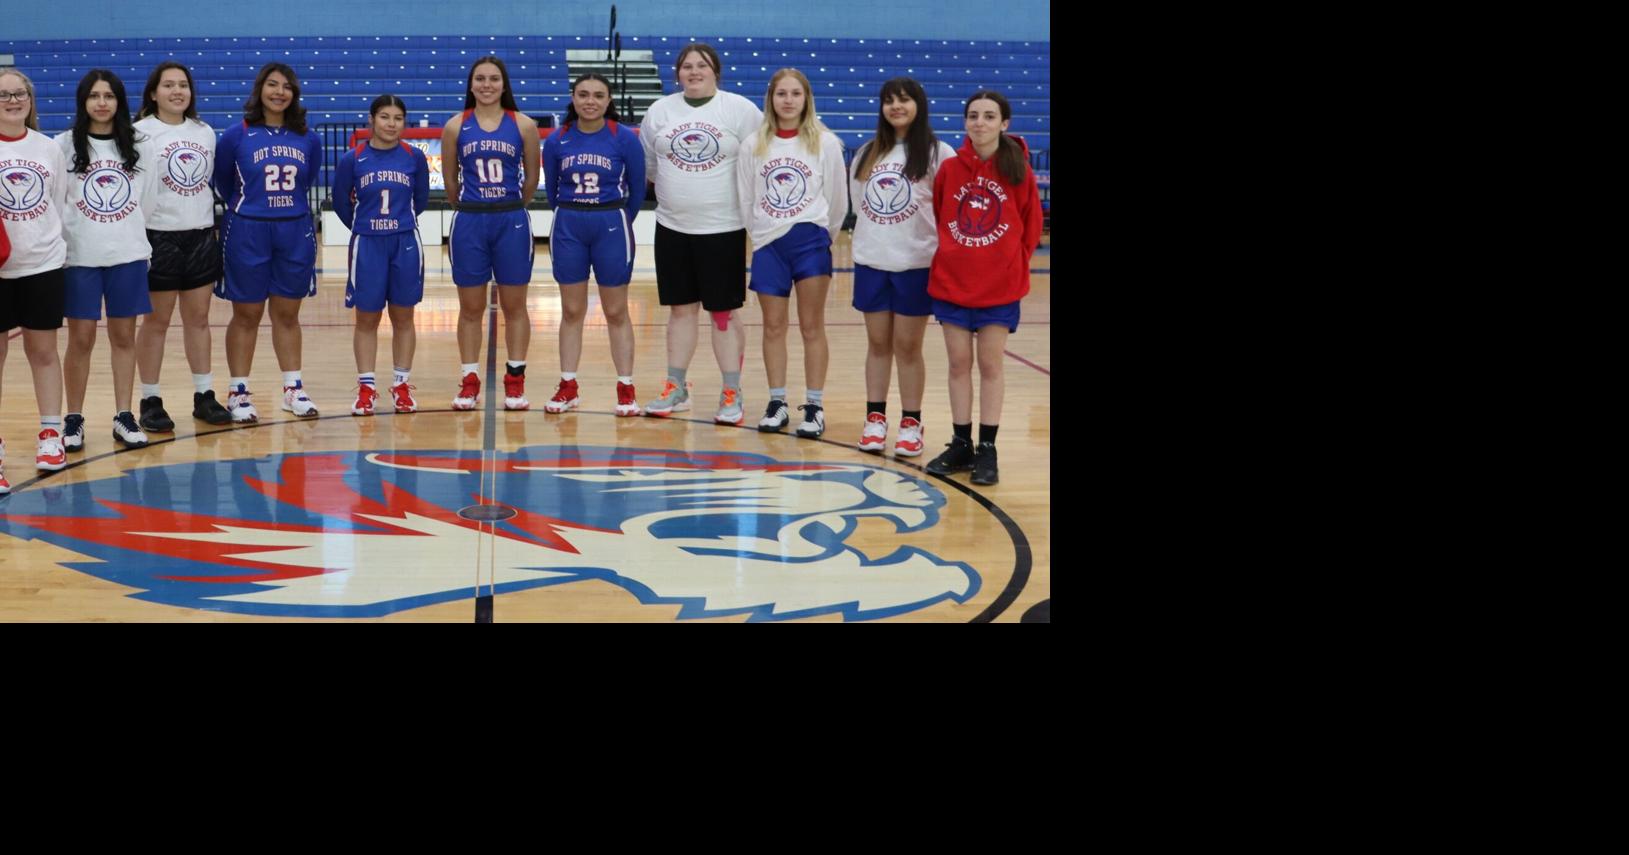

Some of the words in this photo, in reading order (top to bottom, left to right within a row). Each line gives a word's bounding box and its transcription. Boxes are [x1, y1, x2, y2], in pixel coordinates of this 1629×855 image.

[666, 122, 692, 140] LADY
[694, 122, 723, 140] TIGER
[181, 141, 209, 157] TIGER
[253, 147, 269, 164] HOT
[272, 145, 305, 164] SPRINGS
[463, 141, 478, 157] HOT
[480, 140, 516, 157] SPRINGS
[15, 159, 50, 179] TIGER
[475, 158, 504, 184] 10
[577, 153, 612, 171] SPRINGS
[760, 158, 782, 178] LADY
[784, 157, 812, 180] TIGER
[264, 164, 298, 192] 23
[360, 172, 375, 189] HOT
[377, 170, 410, 188] SPRINGS
[572, 172, 600, 194] 12
[267, 195, 294, 208] TIGERS
[380, 189, 390, 215] 1
[478, 187, 507, 199] TIGERS
[76, 199, 138, 223] BASKETBALL
[370, 219, 399, 231] TIGERS
[947, 220, 1009, 248] BASKETBALL
